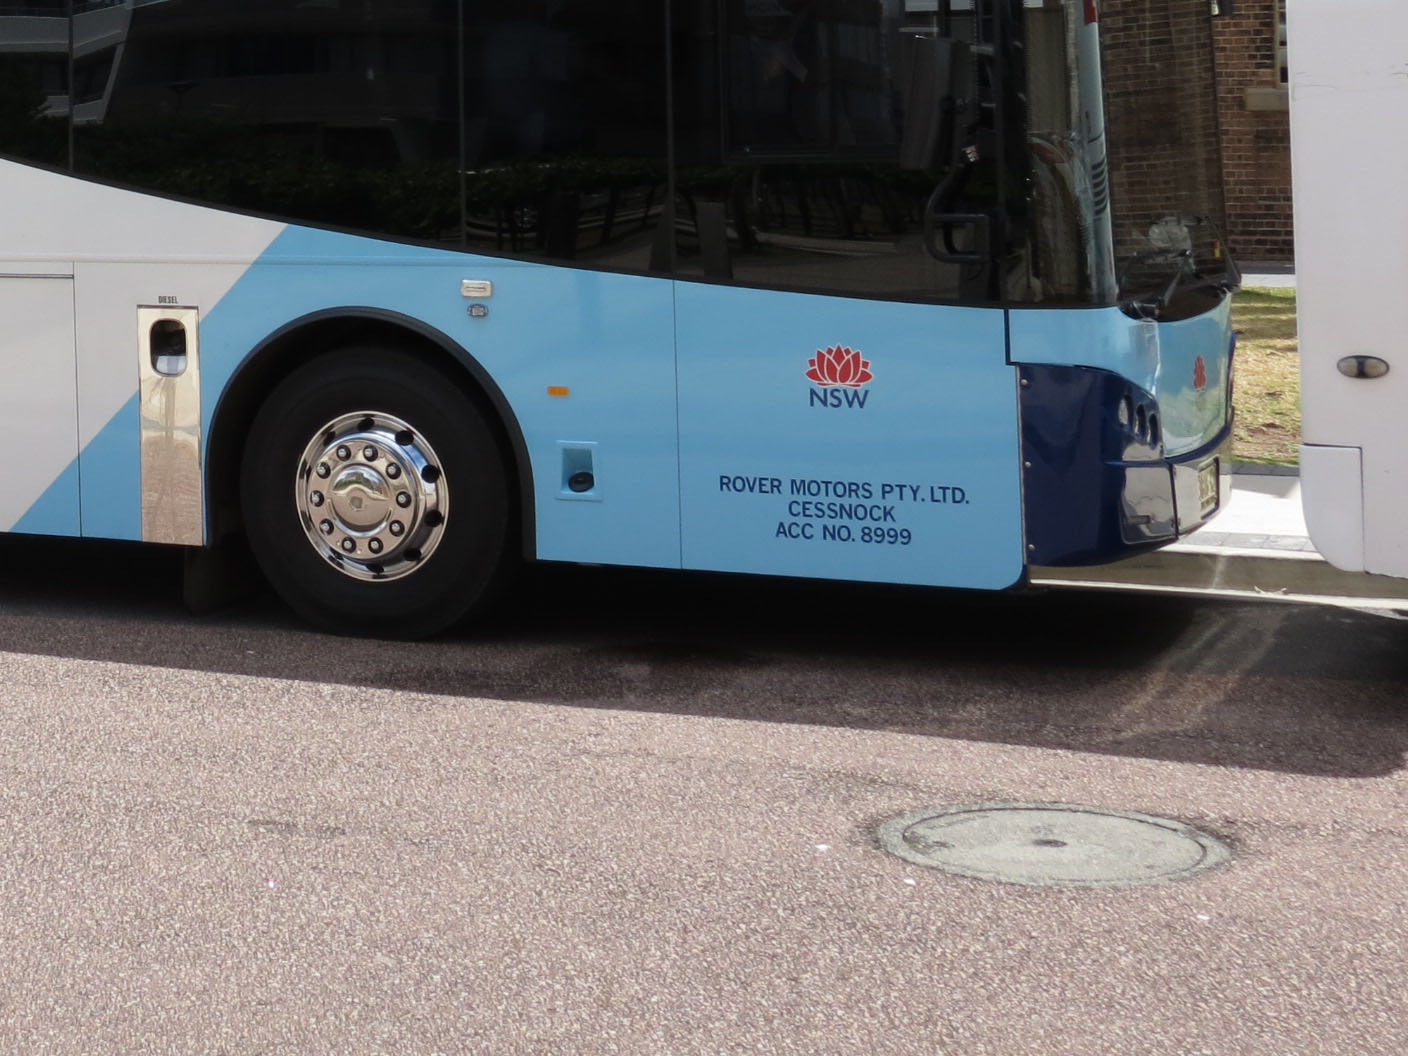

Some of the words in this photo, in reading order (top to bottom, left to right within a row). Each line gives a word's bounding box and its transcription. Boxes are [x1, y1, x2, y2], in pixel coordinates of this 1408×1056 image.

[158, 295, 178, 304] DIESEL
[809, 388, 869, 409] NSW
[719, 475, 782, 495] ROVER
[790, 479, 873, 500] MOTORS
[881, 484, 925, 503] PTY.
[930, 486, 970, 505] LTD.
[788, 500, 897, 523] CESSNOCK
[775, 521, 814, 540] ACC
[822, 524, 855, 543] NO.
[860, 526, 912, 545] 8999
